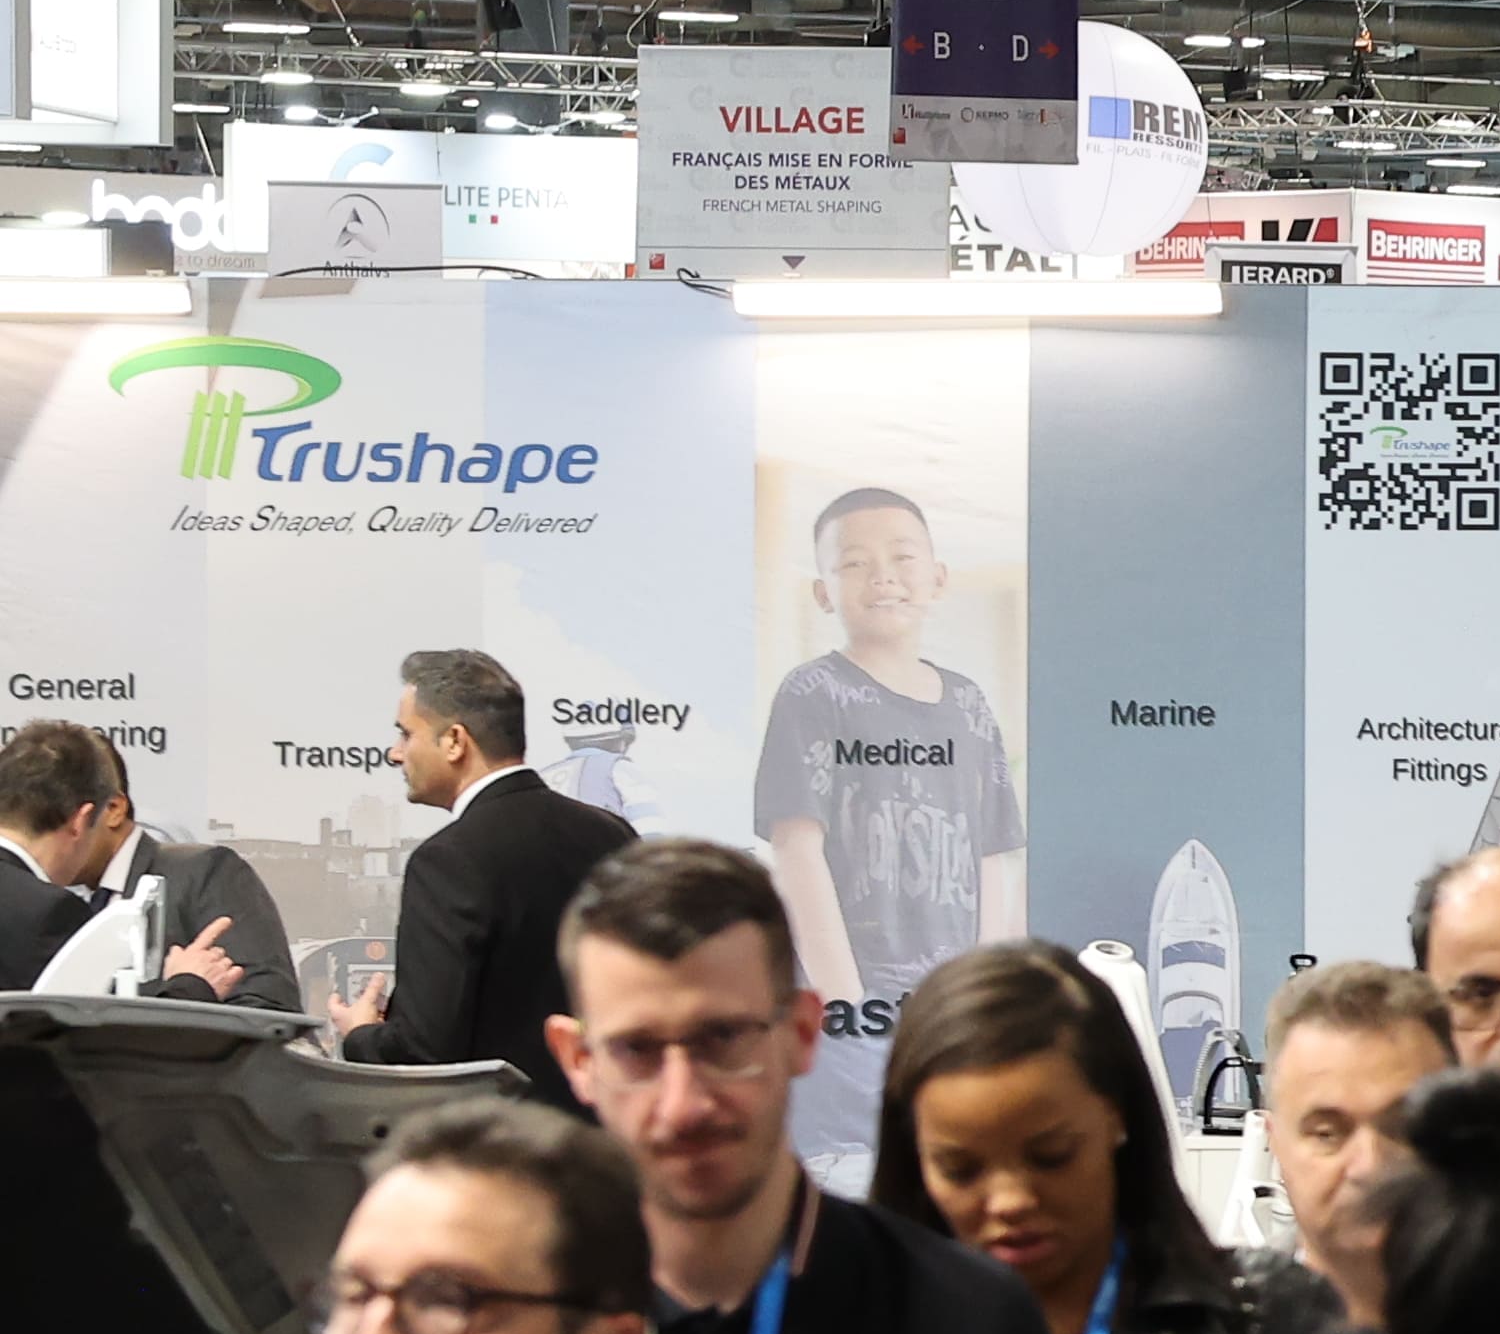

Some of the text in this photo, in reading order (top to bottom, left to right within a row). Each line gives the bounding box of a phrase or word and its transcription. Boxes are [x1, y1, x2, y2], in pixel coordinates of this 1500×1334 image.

[934, 32, 1029, 61] B D
[720, 106, 864, 134] VILLAGE
[672, 152, 842, 171] FRANÇAIS MISE EN
[735, 172, 850, 191] DES MÉTAUX
[703, 199, 882, 214] FRENCH METAL SHAPING
[1372, 231, 1481, 263] BEHRINGER
[251, 421, 599, 493] Trushape
[171, 505, 598, 535] Ideas Shaped, Quality Delivered
[9, 673, 136, 701] General
[552, 698, 690, 728] Saddlery
[1109, 700, 1216, 727] Marine
[834, 739, 954, 767] Medical
[1392, 758, 1488, 786] Fittings
